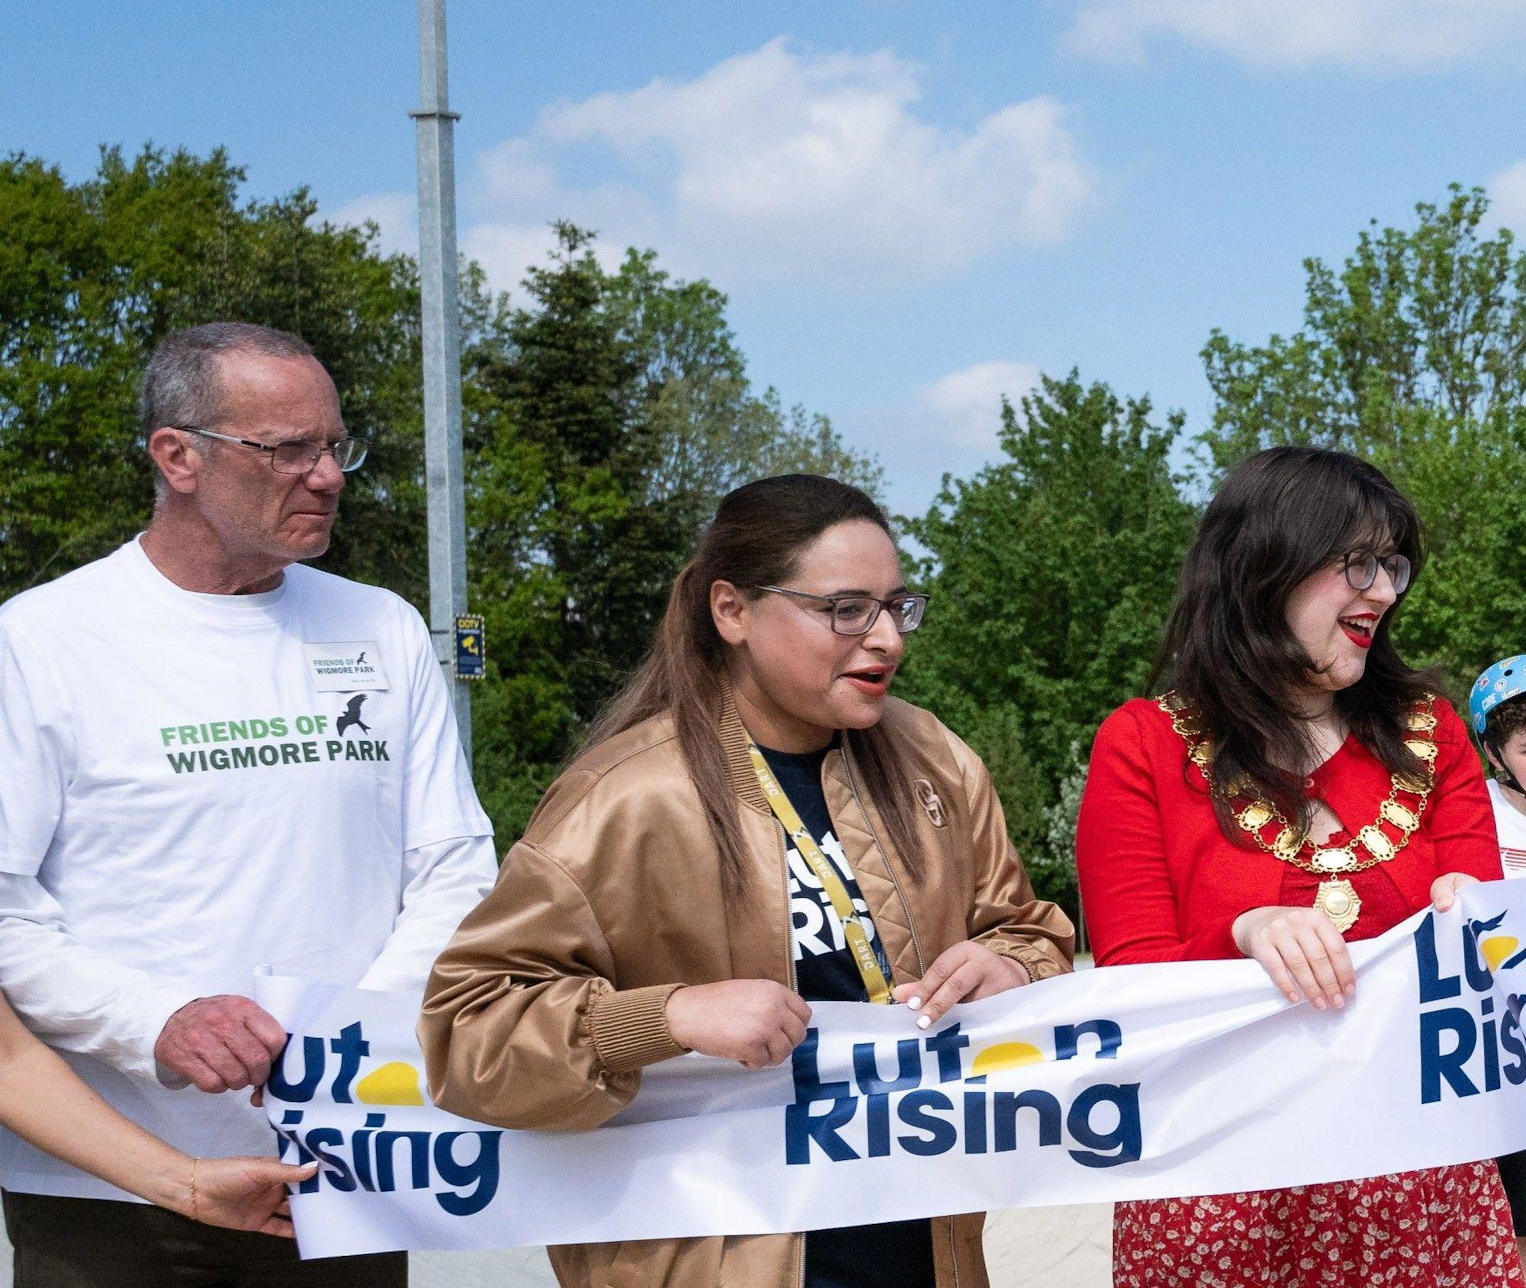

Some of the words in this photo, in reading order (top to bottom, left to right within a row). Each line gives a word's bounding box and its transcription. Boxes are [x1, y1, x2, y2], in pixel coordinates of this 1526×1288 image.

[316, 666, 353, 674] WIGMORE
[160, 717, 289, 747] FRIENDS
[295, 715, 328, 736] OF
[166, 741, 320, 774] WIGMORE
[326, 740, 391, 762] PARK
[785, 1074, 1142, 1169] Rising
